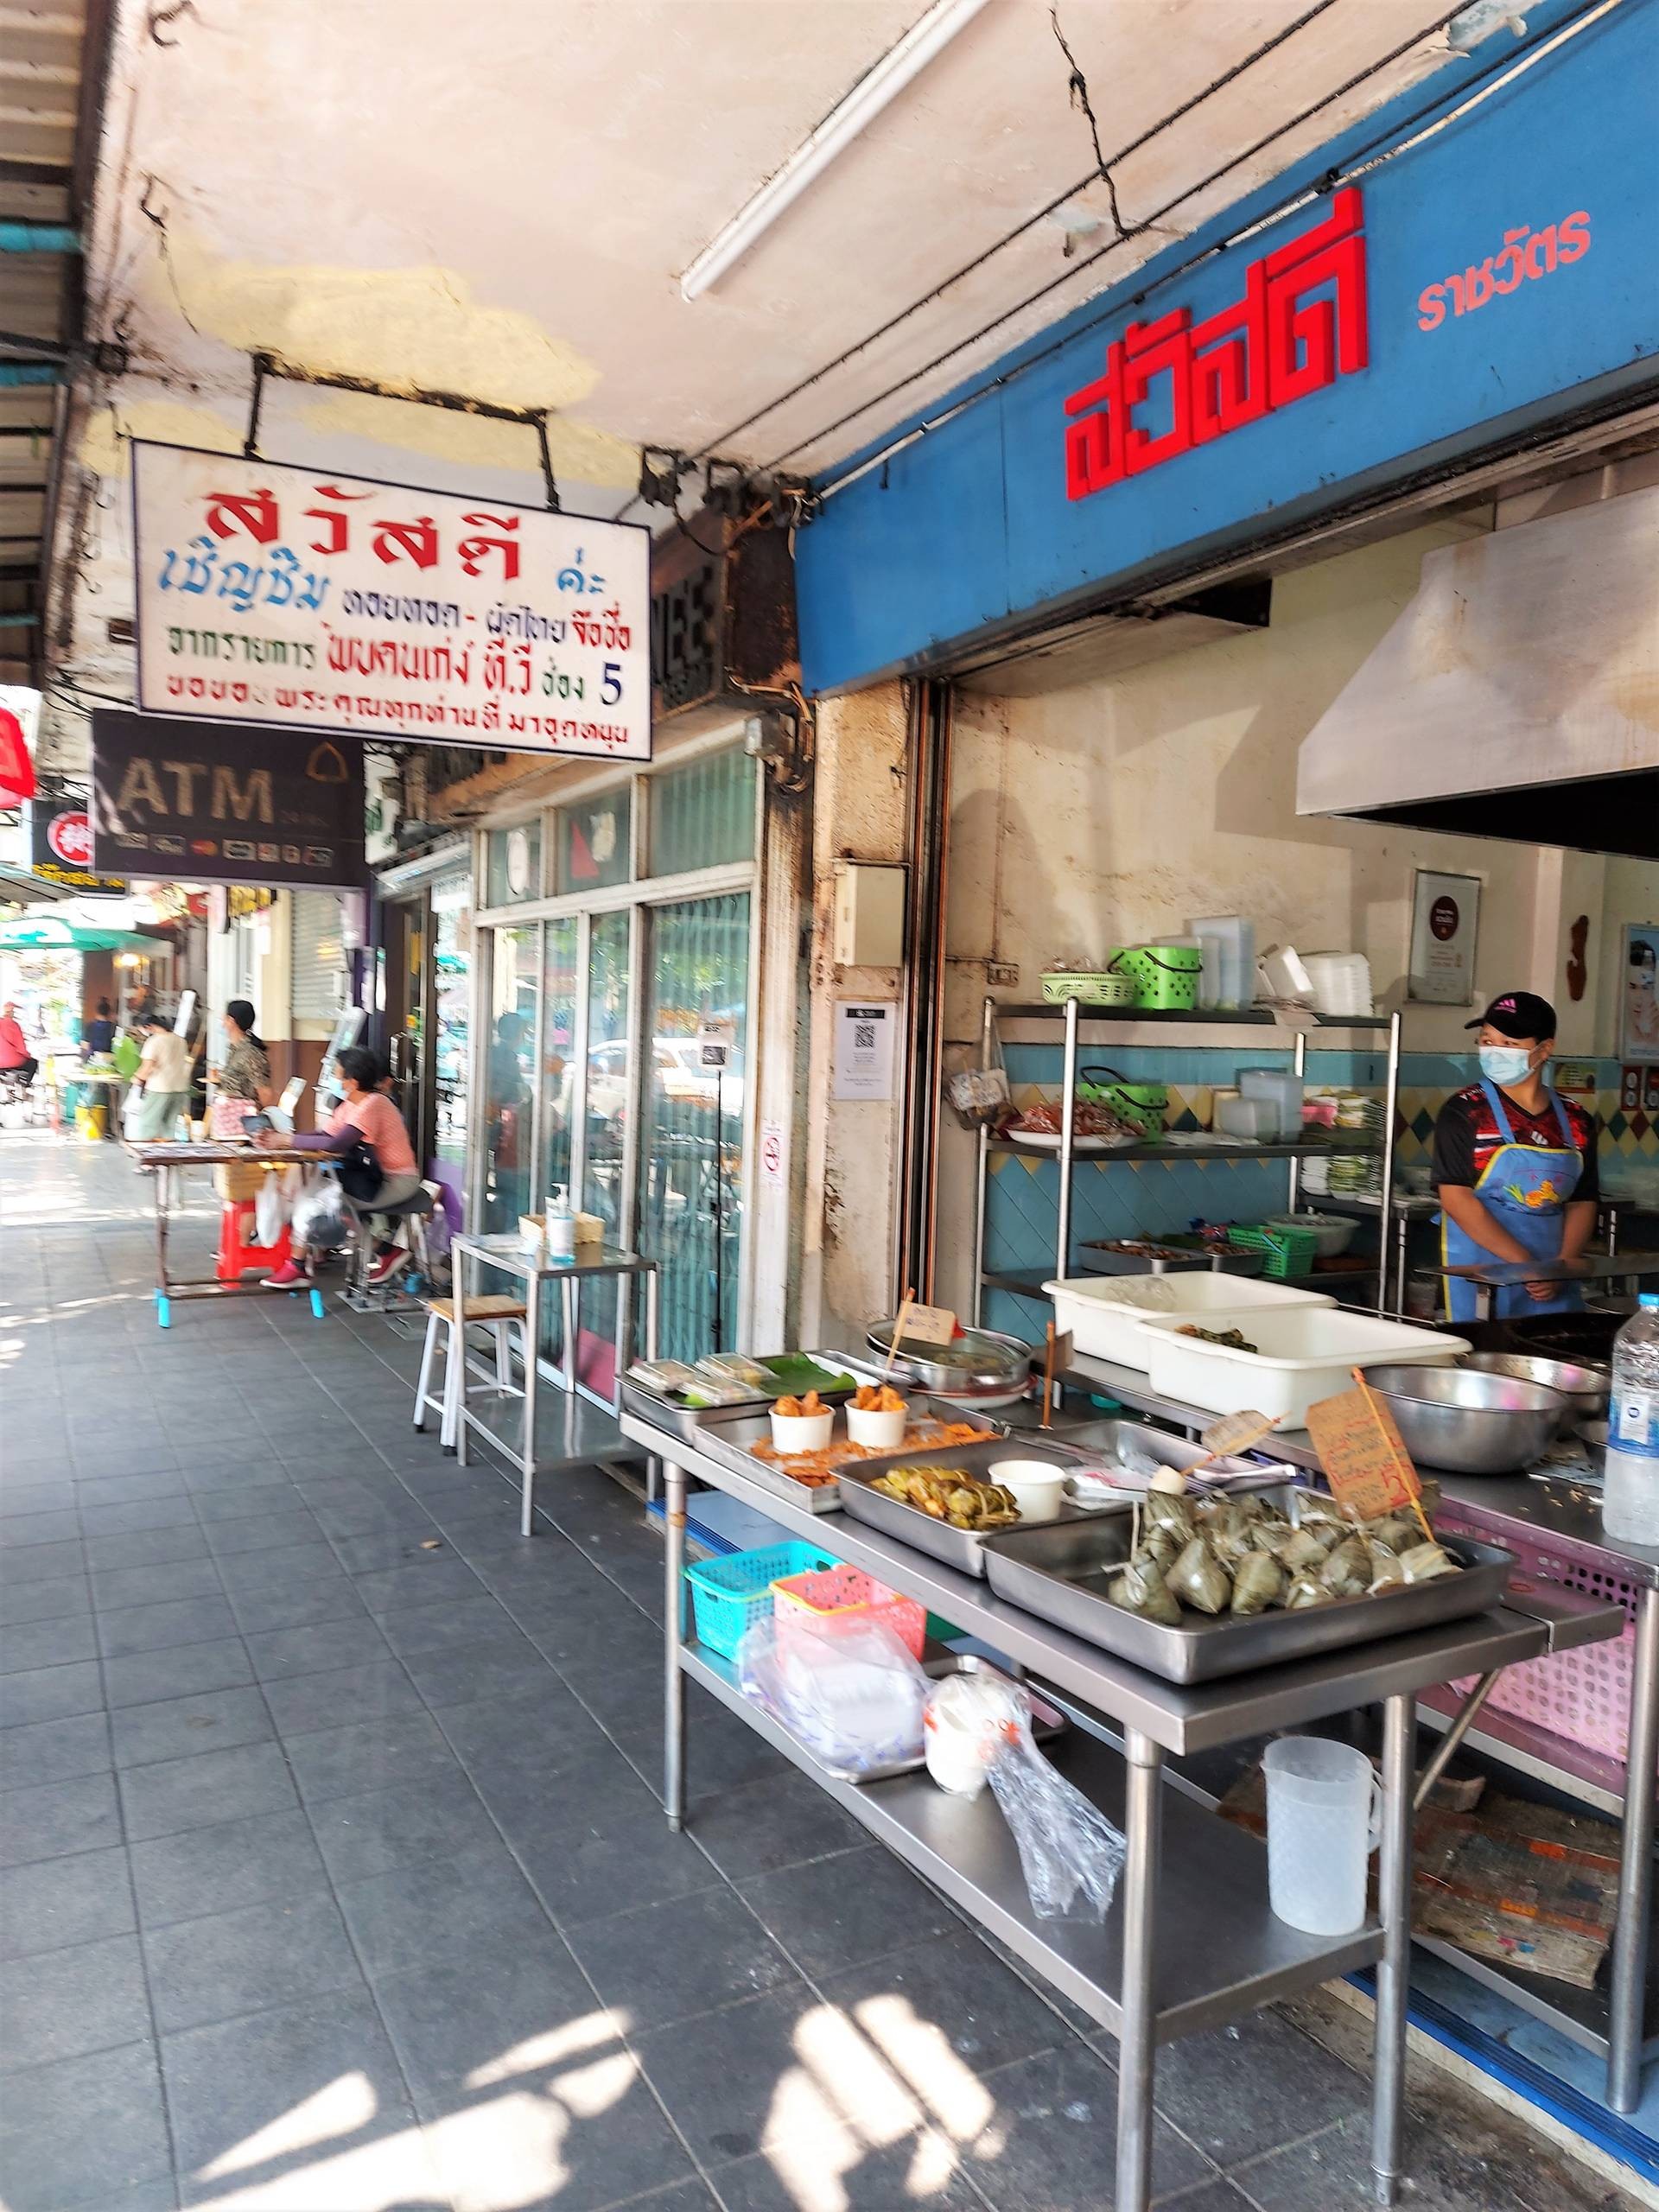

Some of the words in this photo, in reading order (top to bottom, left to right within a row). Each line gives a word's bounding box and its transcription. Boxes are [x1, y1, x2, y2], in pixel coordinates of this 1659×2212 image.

[1417, 210, 1592, 333] ราชวัตร
[158, 536, 332, 614] เชิญชิม
[342, 588, 460, 629] หอยทอด
[486, 601, 566, 644] ผัดไทย
[202, 484, 521, 582] สวัสดี
[556, 548, 606, 594] ค่ะ
[167, 626, 316, 670] จากรายการ
[542, 656, 585, 701] ช่อง
[599, 661, 624, 706] 5
[118, 757, 275, 824] ATM
